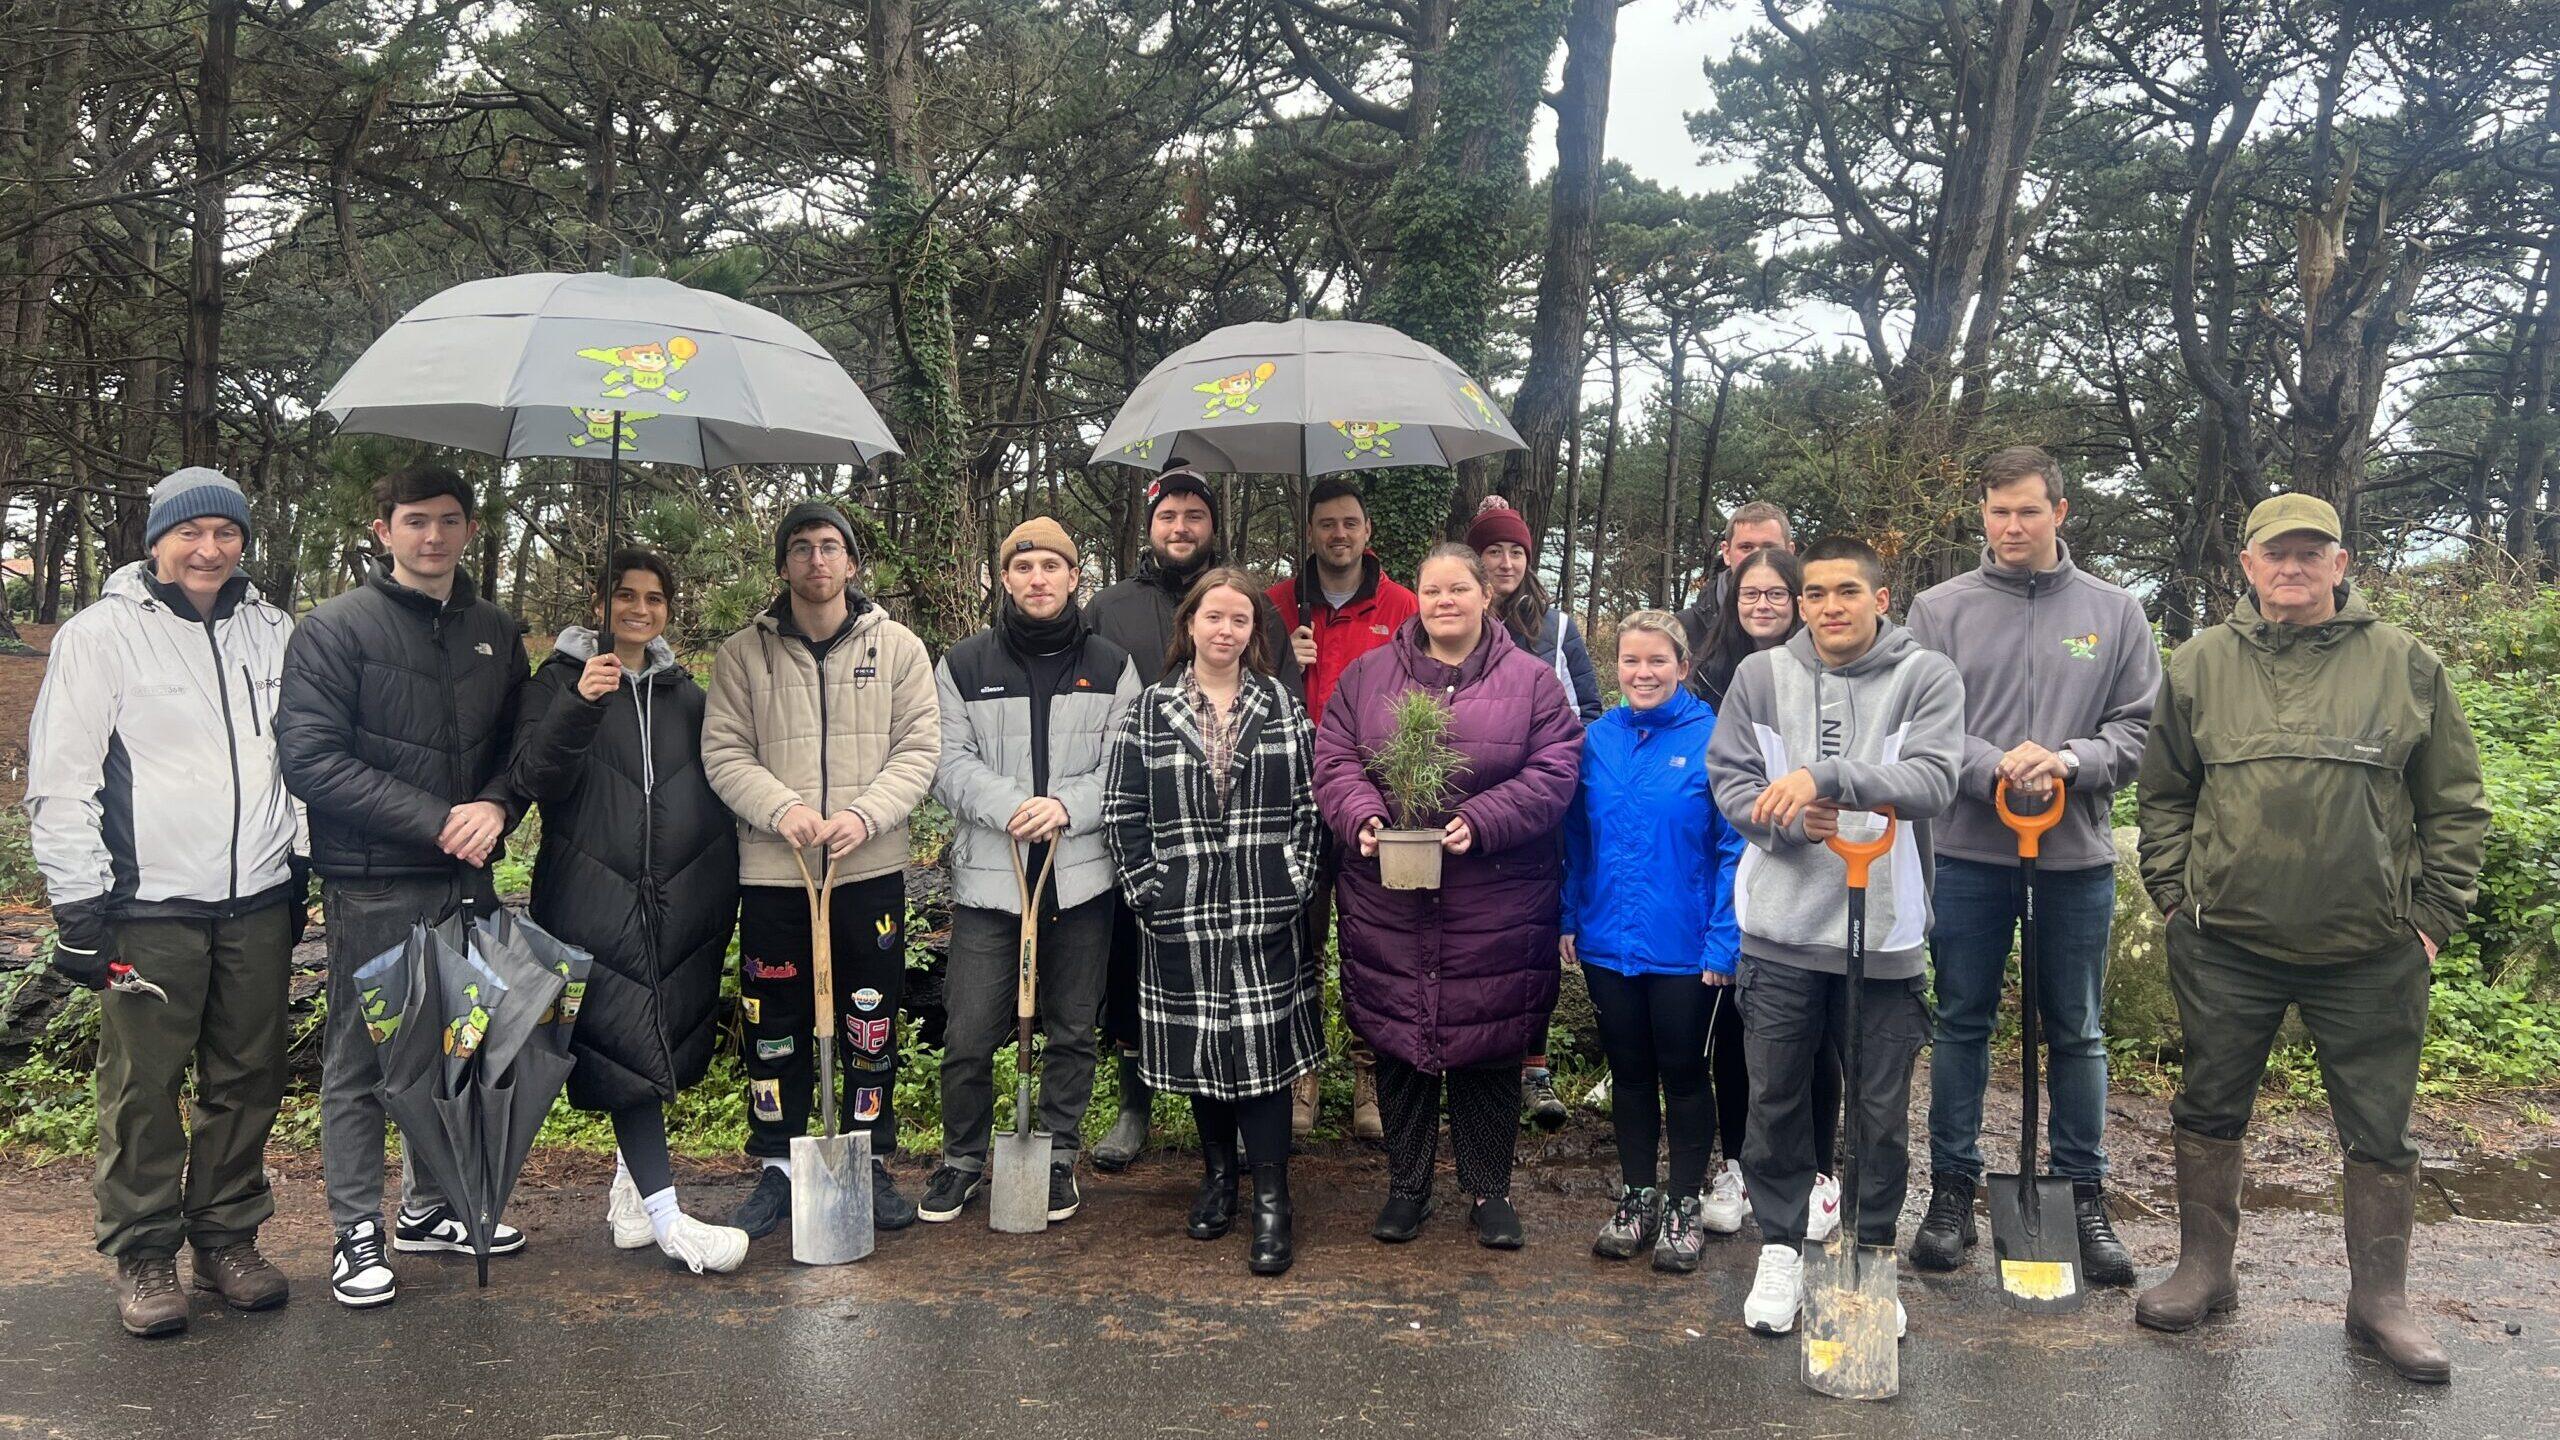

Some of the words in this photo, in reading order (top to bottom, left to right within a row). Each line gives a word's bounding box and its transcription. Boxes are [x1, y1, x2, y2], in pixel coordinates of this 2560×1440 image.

[1822, 719, 1841, 760] NIK
[1852, 918, 1860, 958] FISKARS
[846, 1013, 890, 1055] 98
